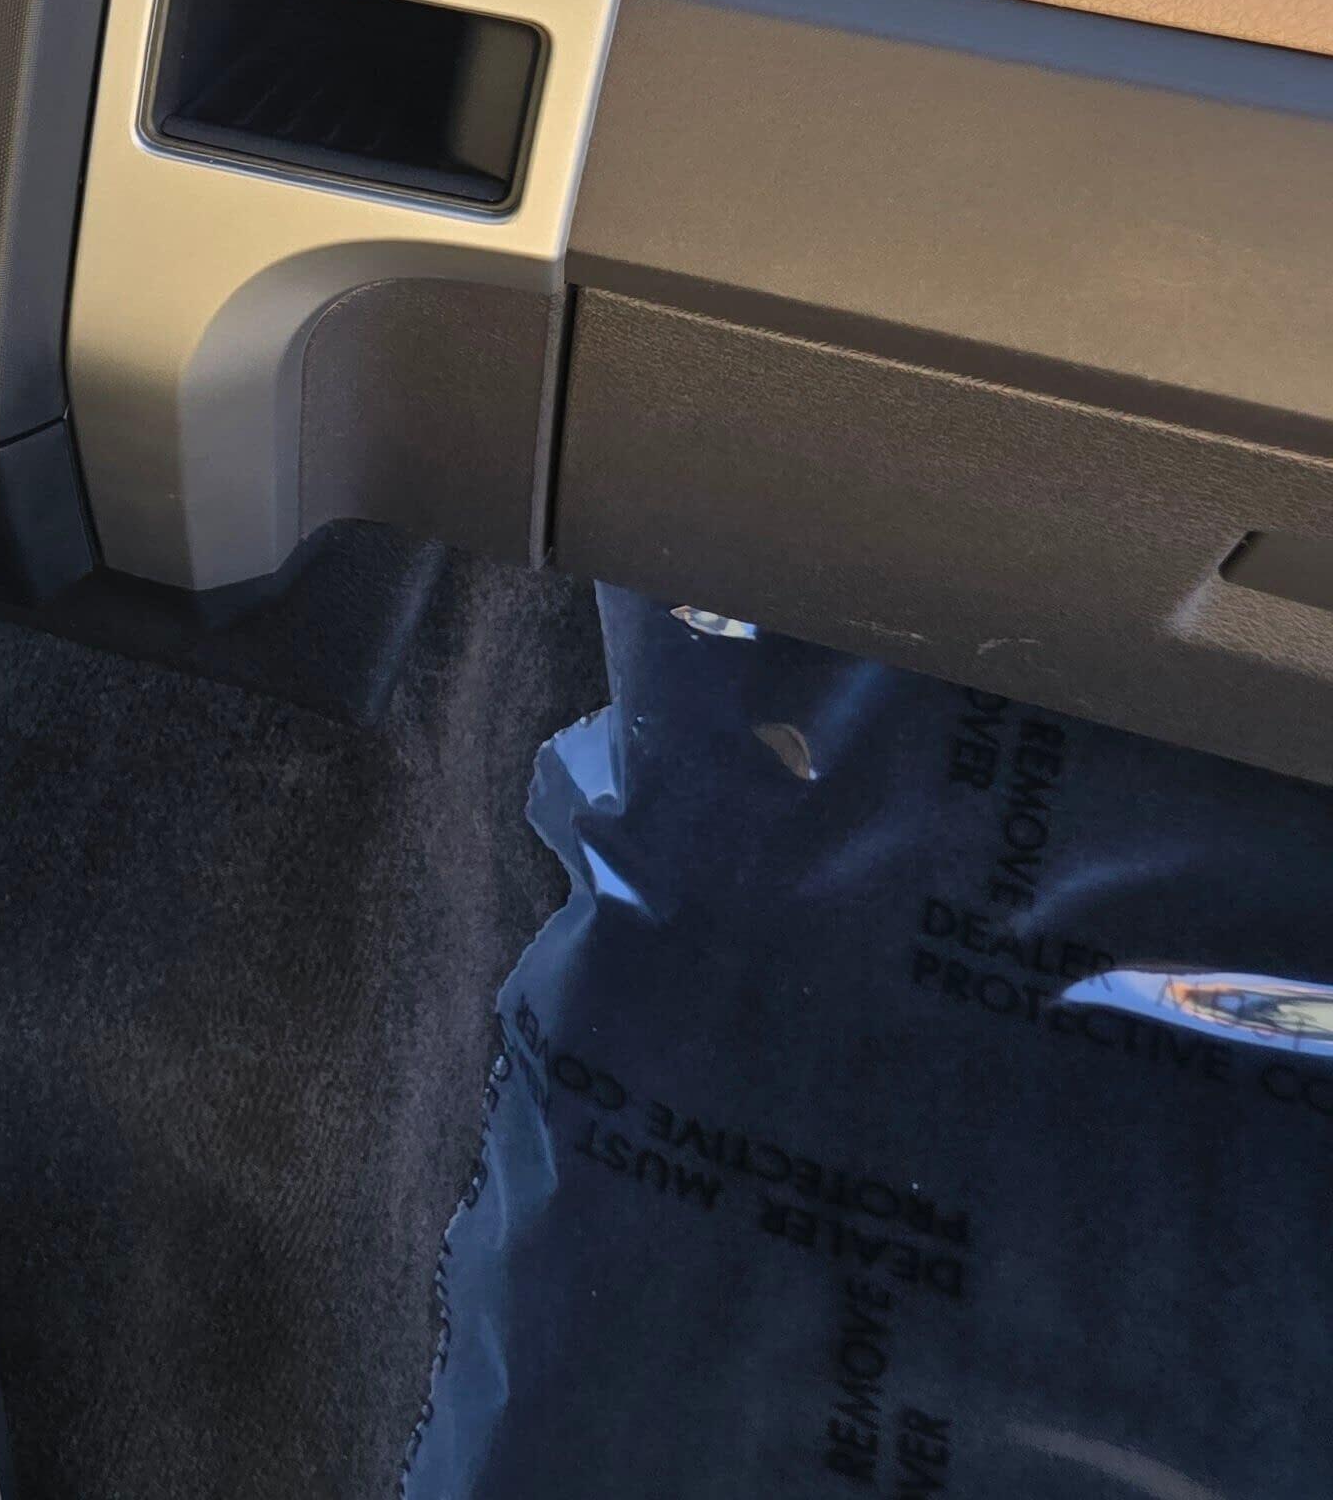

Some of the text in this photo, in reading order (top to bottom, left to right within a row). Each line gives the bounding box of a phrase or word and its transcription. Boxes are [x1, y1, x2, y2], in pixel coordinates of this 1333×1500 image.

[923, 893, 1117, 994] DEALER
[912, 947, 1233, 1084] PROTECTIVE
[573, 1118, 725, 1212] MUST
[645, 1098, 971, 1246] PROTECTIVE
